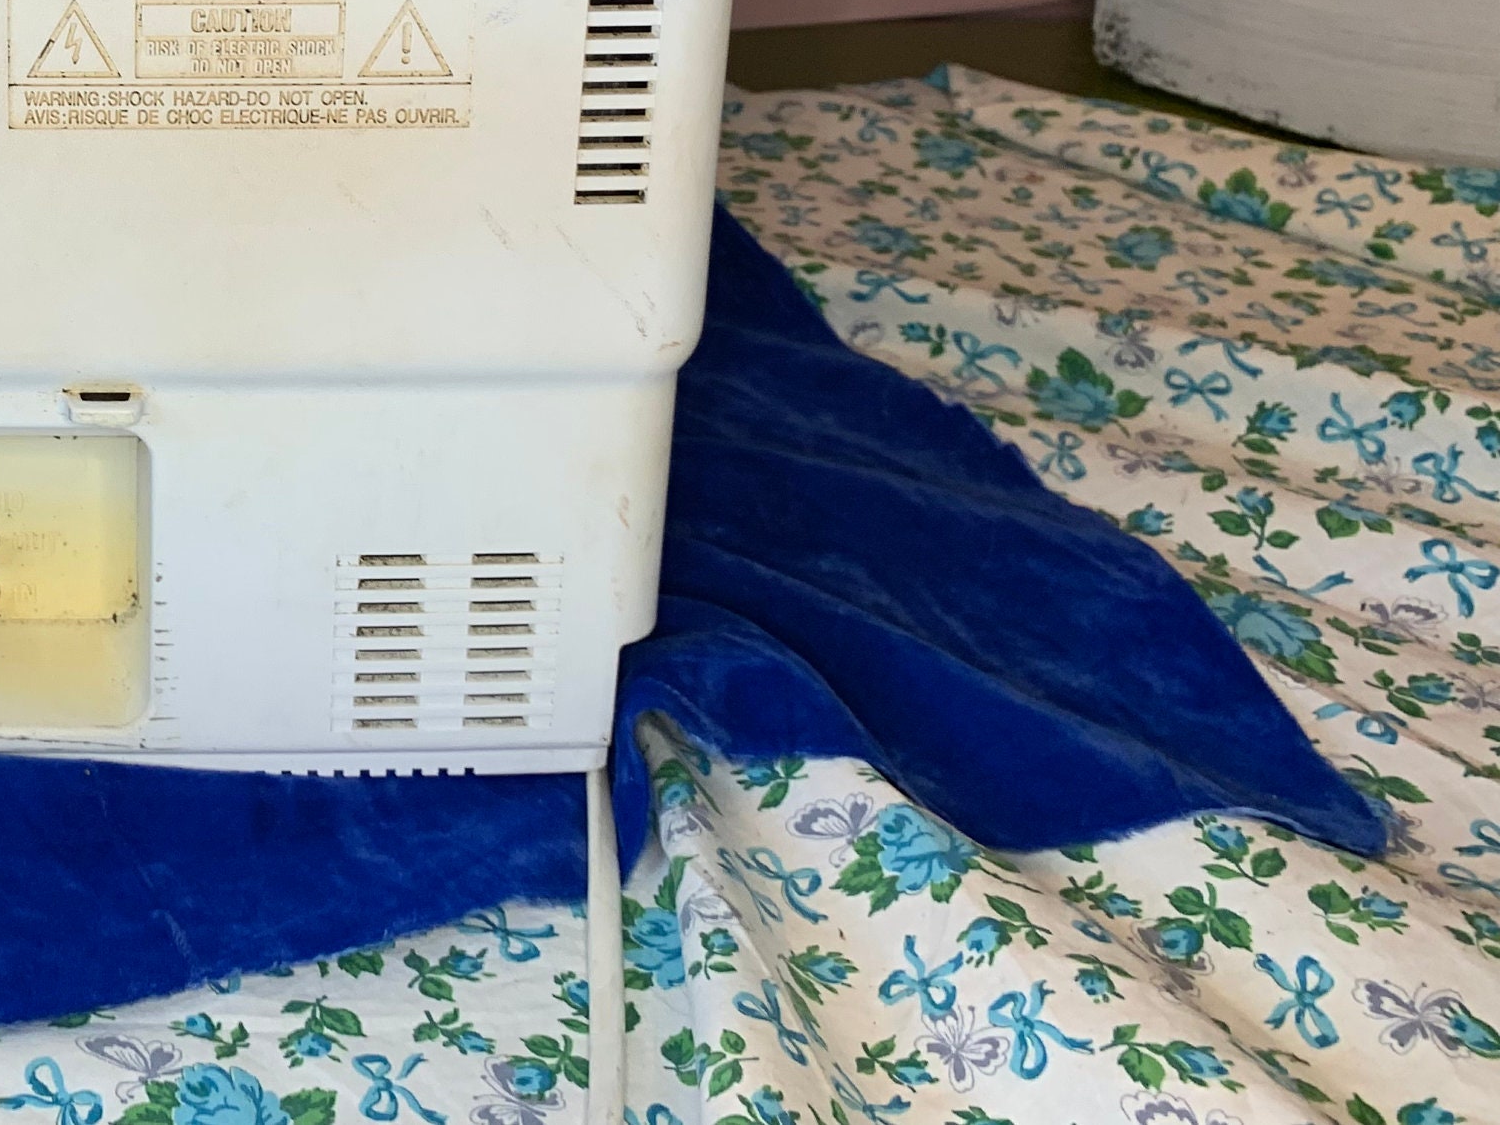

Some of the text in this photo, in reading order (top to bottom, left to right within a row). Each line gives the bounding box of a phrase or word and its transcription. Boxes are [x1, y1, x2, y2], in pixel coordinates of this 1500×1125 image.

[191, 8, 292, 34] CAUTION
[145, 39, 335, 56] RISK OF ELECTRIC SHOCK
[190, 59, 292, 74] DO NOT OPEN
[173, 90, 271, 106] HAZARD-DO
[279, 90, 314, 106] NOT
[321, 90, 369, 106] OPEN.
[137, 109, 160, 126] DE
[167, 109, 213, 126] CHOC
[220, 109, 348, 126] ELECTRIQUE-NE
[355, 109, 387, 126] PAS
[394, 109, 460, 126] OUVRIR.
